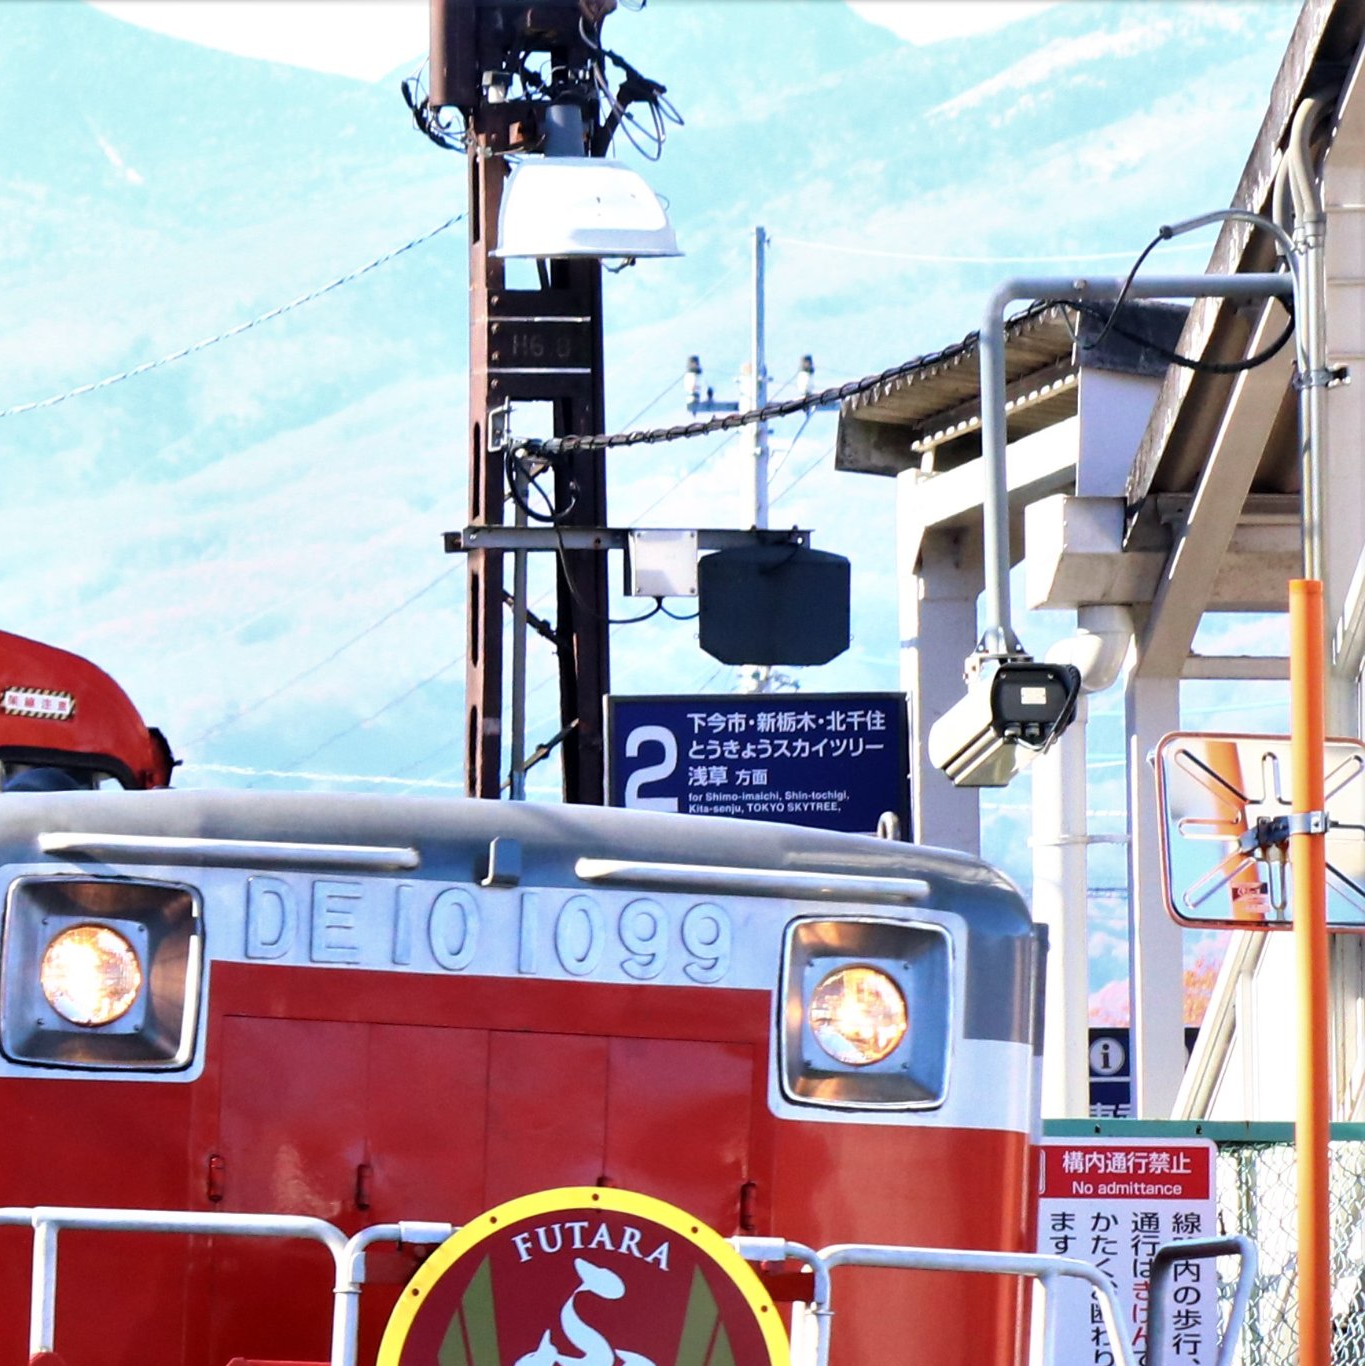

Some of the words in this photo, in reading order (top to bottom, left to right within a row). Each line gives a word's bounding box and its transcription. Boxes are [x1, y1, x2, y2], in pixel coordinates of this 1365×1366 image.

[688, 737, 884, 760] とうきょうスカイツリー
[624, 725, 679, 812] 2
[688, 765, 729, 787] 浅草
[735, 768, 768, 786] 方面
[688, 792, 703, 802] for
[747, 802, 785, 813] TOKYO
[787, 801, 841, 813] SKYTREE,
[245, 875, 480, 972] DE10
[518, 890, 732, 984] 1099
[1062, 1150, 1192, 1175] 構内通行禁止
[1072, 1181, 1094, 1195] No
[1097, 1181, 1183, 1195] admittance
[1049, 1211, 1077, 1255] ます
[510, 1221, 671, 1272] FUTARA
